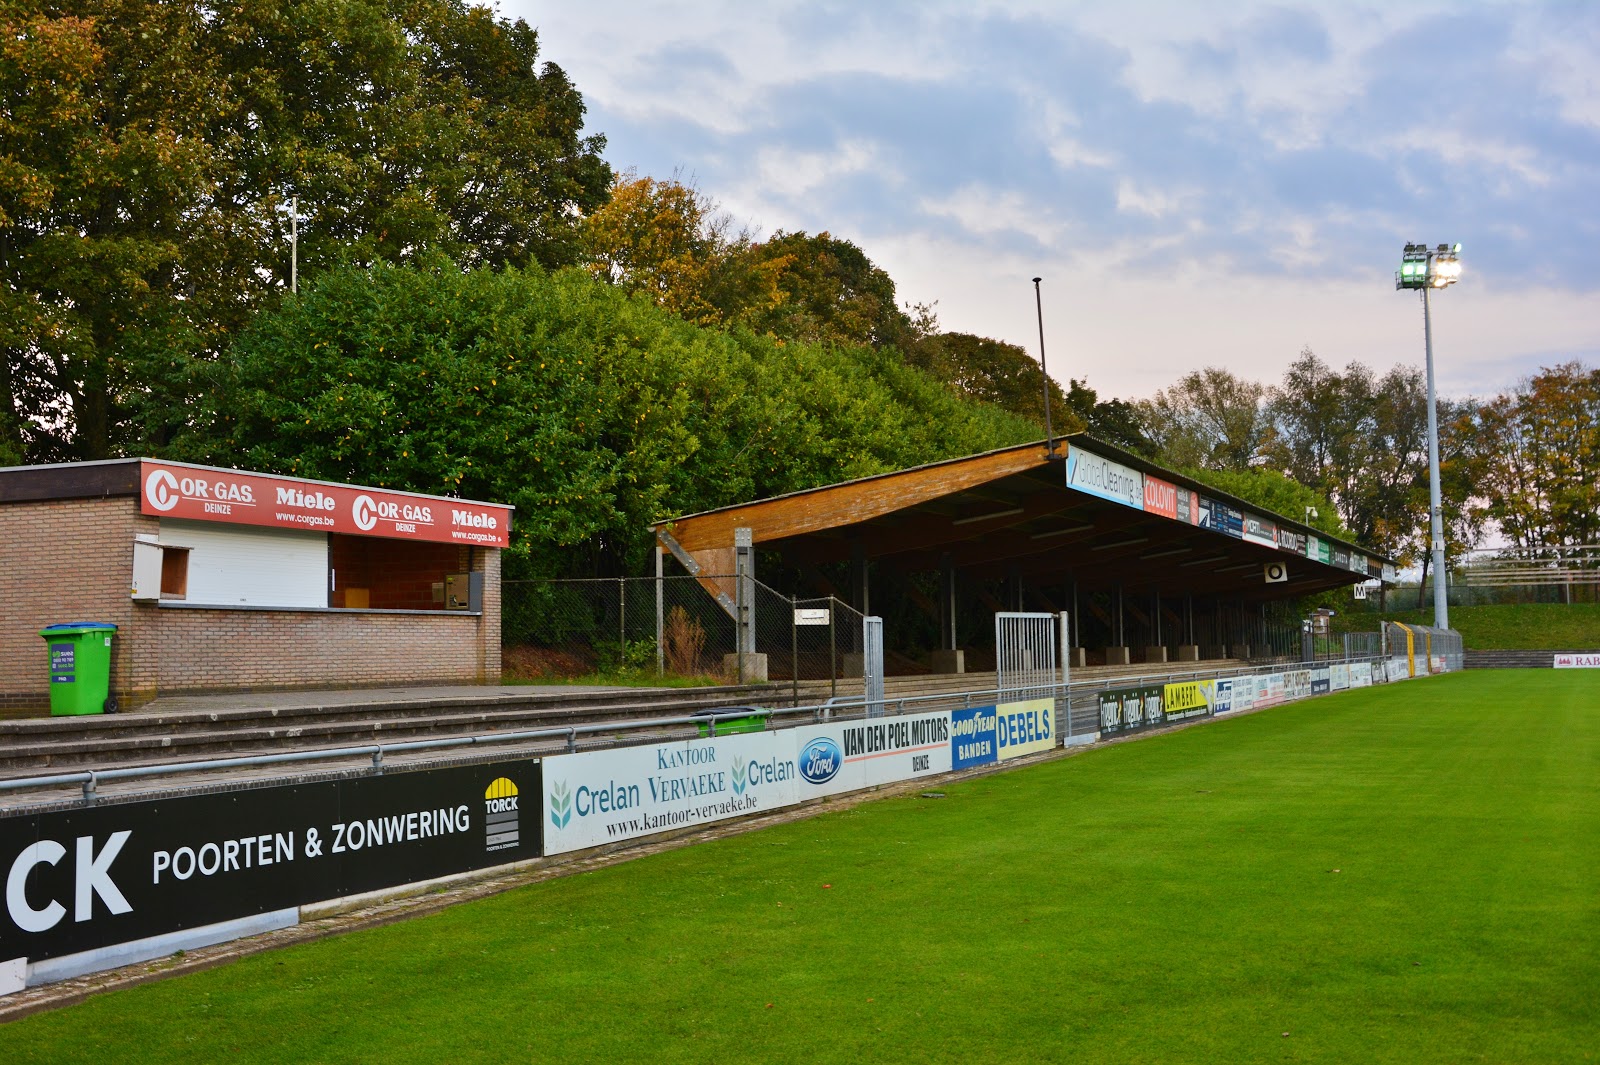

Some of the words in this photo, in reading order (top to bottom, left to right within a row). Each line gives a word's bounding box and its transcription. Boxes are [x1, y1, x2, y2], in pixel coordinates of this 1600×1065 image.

[276, 487, 335, 510] Miele
[1145, 481, 1175, 512] COLOVIT
[204, 502, 231, 515] DEINZE
[276, 512, 334, 526] www.corgas.be
[452, 510, 497, 529] Miele
[395, 523, 416, 533] DEINZE
[452, 531, 496, 542] www.corgas.be
[1268, 564, 1283, 580] O
[1355, 586, 1365, 598] M
[1166, 685, 1197, 709] LAMBERT
[843, 725, 865, 757] VAN
[867, 722, 886, 752] DEN
[888, 719, 910, 748] POEL
[912, 716, 949, 746] MOTORS
[951, 712, 996, 738] GOODYEAR
[997, 709, 1050, 748] DEBELS
[806, 745, 835, 774] Ford
[958, 741, 991, 761] BANDEN
[748, 756, 795, 786] Crelan
[912, 754, 930, 772] DEINZE
[575, 780, 640, 817] Crelan
[647, 771, 726, 803] VERVAEKE
[485, 797, 519, 814] TORCK
[606, 794, 758, 837] www.kantoor-vervaeke.be
[6, 830, 134, 932] CK
[153, 831, 294, 884] POORTEN
[304, 827, 323, 858] &
[331, 805, 470, 853] ZONWERING
